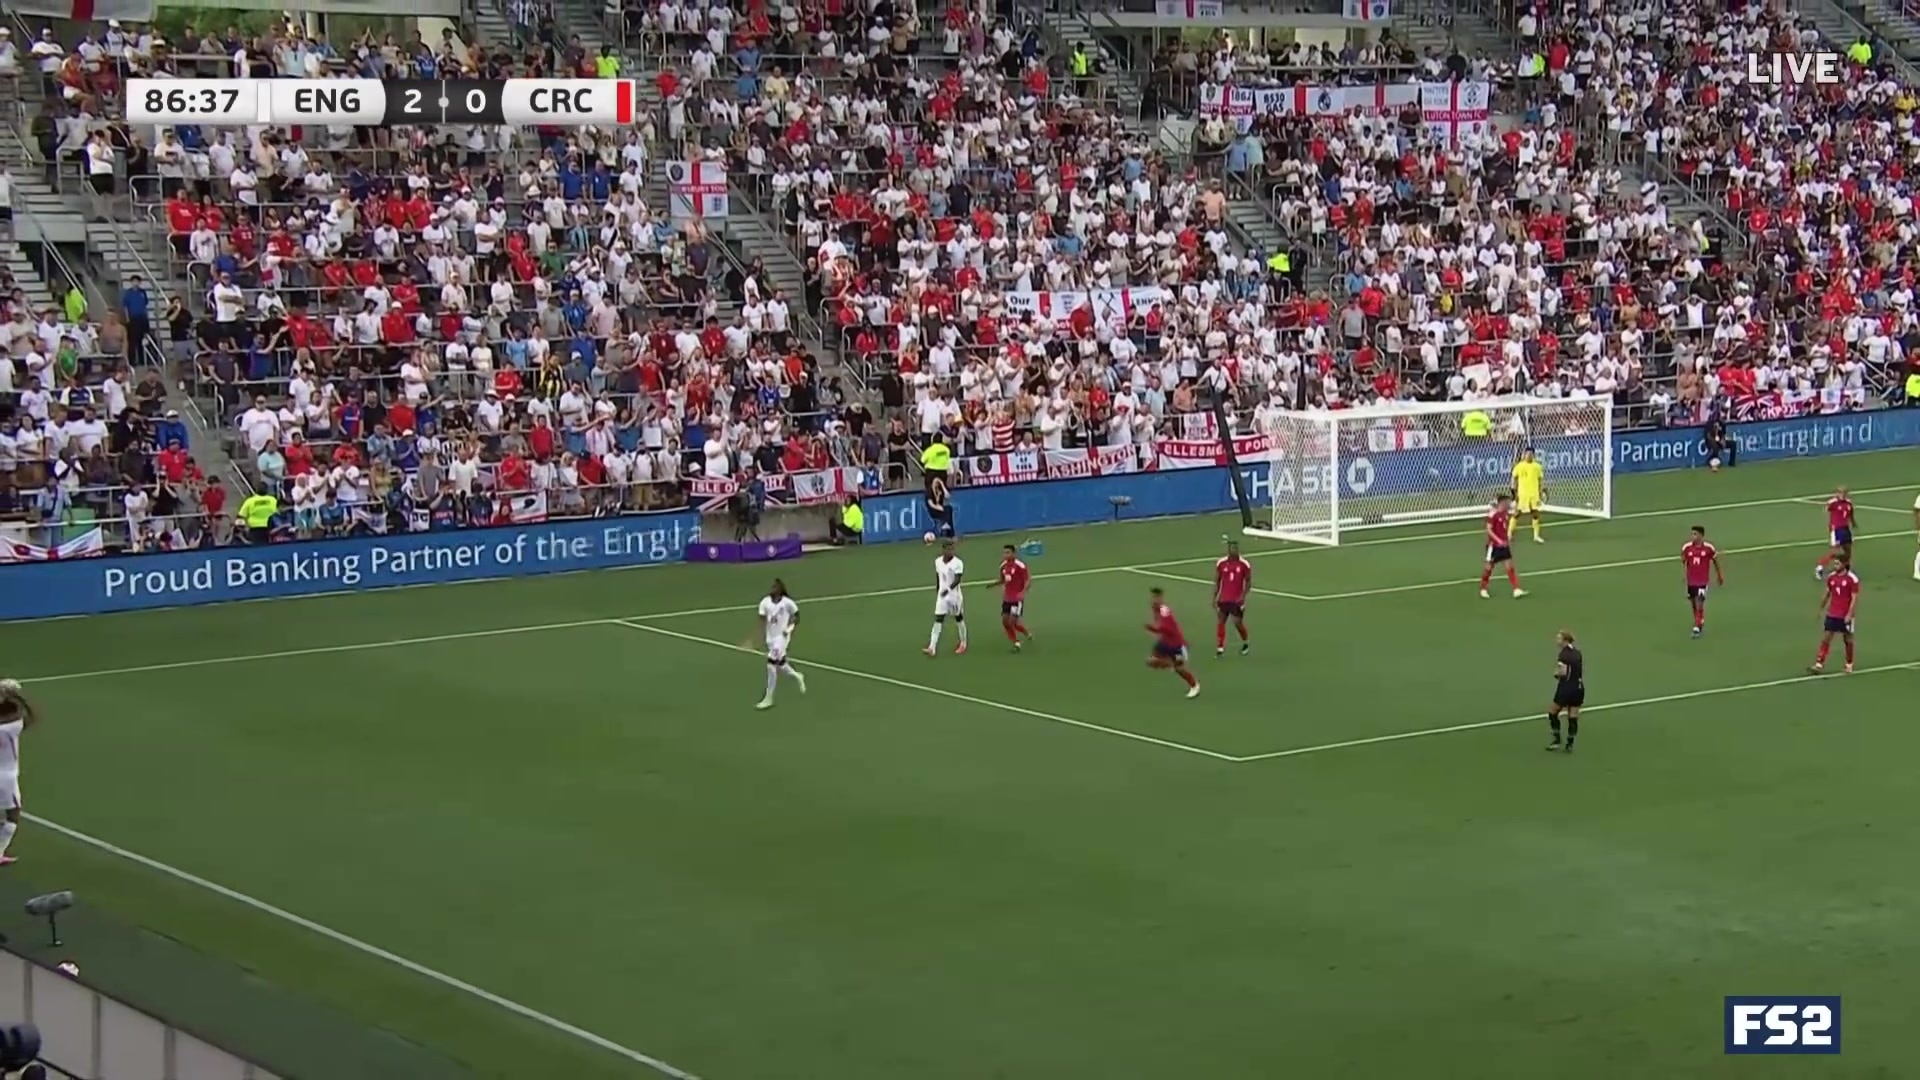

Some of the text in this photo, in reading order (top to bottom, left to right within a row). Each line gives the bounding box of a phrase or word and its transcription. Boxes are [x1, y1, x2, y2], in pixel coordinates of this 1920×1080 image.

[1426, 111, 1450, 120] LUTON
[1451, 110, 1473, 120] TOWN
[1010, 295, 1031, 306] Our
[1164, 437, 1277, 456] ELLESMEE PORT
[1620, 439, 1693, 463] Partner
[1767, 415, 1873, 455] England
[1052, 444, 1135, 479] ASHINGTON
[1462, 454, 1512, 476] Prou
[1008, 472, 1038, 483] ALBION
[692, 482, 720, 493] ISLE
[105, 560, 213, 597] Proud
[226, 551, 361, 587] Banking
[370, 543, 486, 574] Partner
[495, 533, 527, 565] of
[536, 533, 589, 561] the
